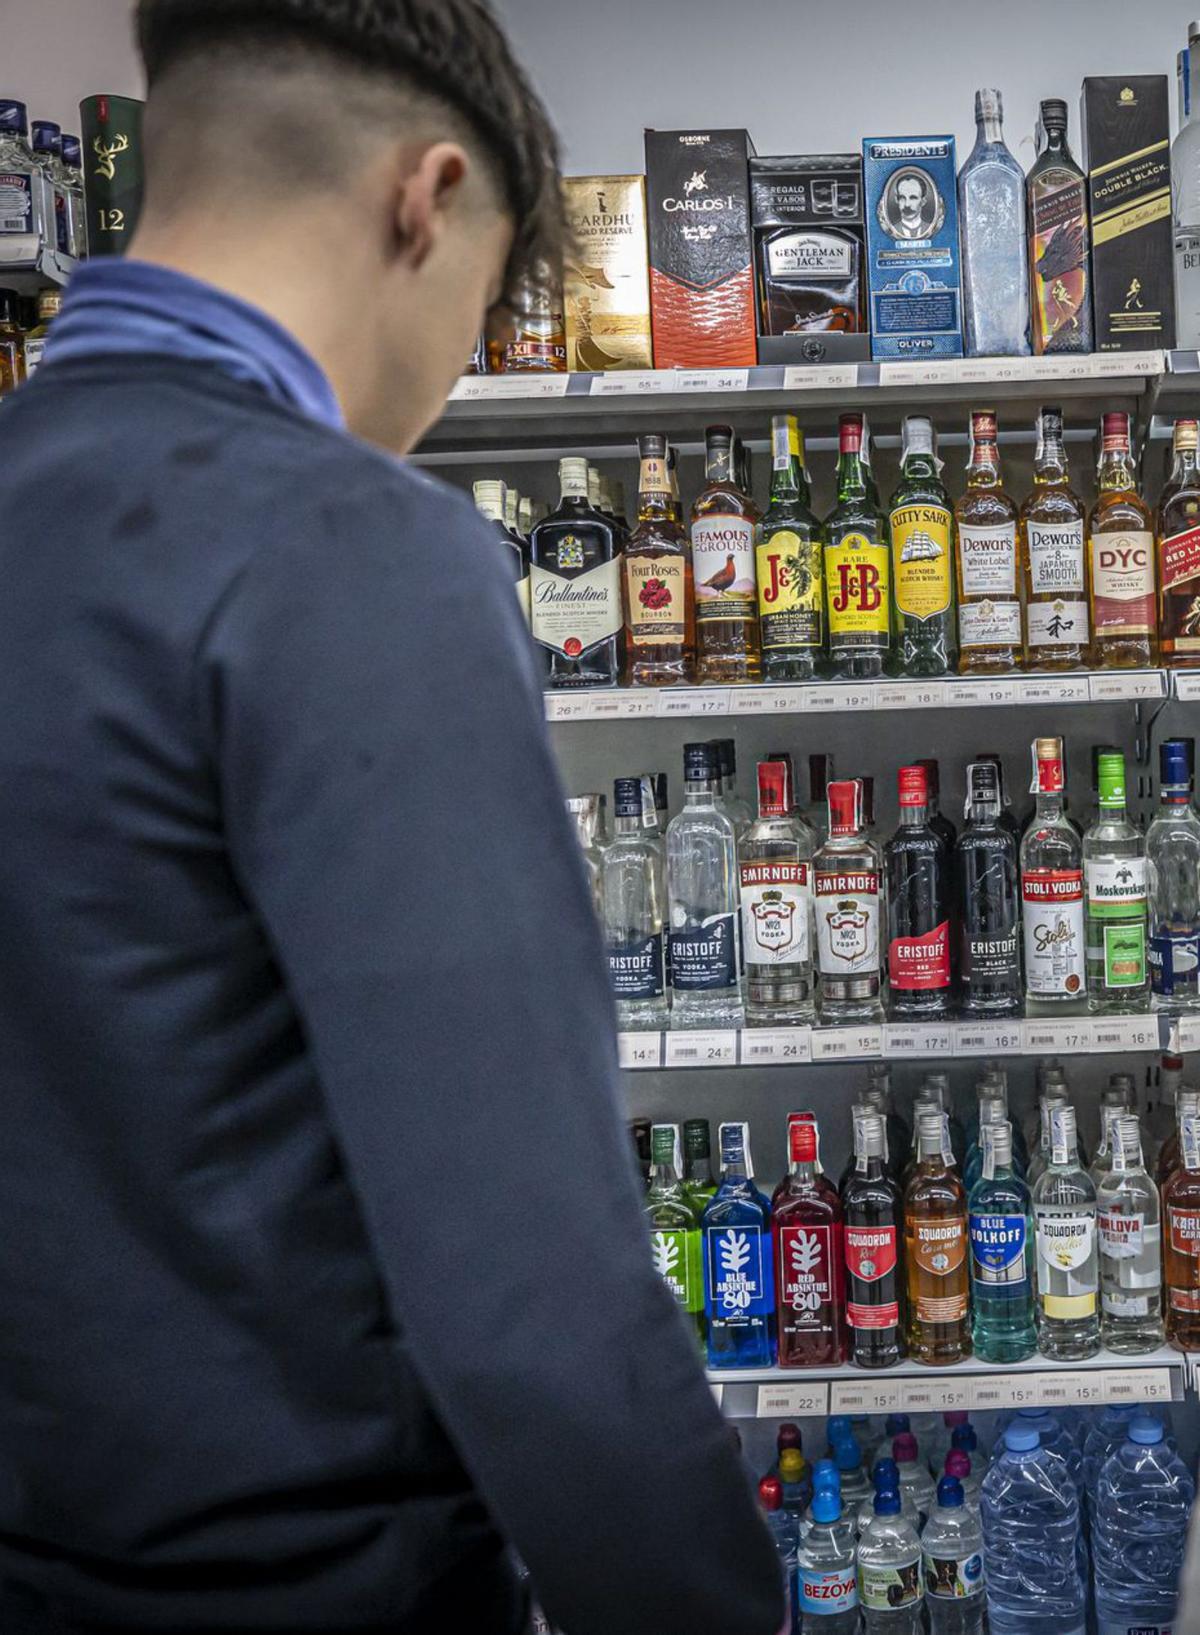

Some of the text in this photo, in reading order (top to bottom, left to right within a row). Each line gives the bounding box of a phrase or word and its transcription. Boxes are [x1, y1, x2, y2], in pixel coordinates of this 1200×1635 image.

[873, 144, 946, 158] PRESIDENTE
[1094, 178, 1133, 198] DOUBLE
[1135, 164, 1167, 182] BLACK
[770, 186, 805, 194] REGALO
[662, 198, 724, 213] CARLOS
[98, 209, 125, 231] 12
[775, 248, 844, 257] GENTLEMAN
[797, 257, 824, 267] JACK
[898, 339, 933, 349] OLIVER
[892, 510, 949, 528] CUTTY SARK
[700, 530, 749, 542] FAMOUS
[1031, 531, 1082, 547] Dewar's
[699, 541, 750, 553] GROUSE
[964, 537, 1013, 553] Dewar's
[1055, 550, 1062, 561] 8
[1100, 548, 1147, 569] DYC
[1166, 549, 1186, 564] RED
[631, 563, 680, 577] Four Roses
[1039, 560, 1078, 569] JAPANESE
[1039, 569, 1078, 580] SMOOTH
[535, 580, 609, 604] Ballantine's
[990, 692, 1003, 700] 19
[1060, 689, 1075, 698] 22
[1134, 686, 1147, 695] 17
[846, 697, 859, 705] 19
[918, 694, 930, 703] 18
[742, 866, 804, 883] SMIRNOFF
[817, 876, 877, 893] SMIRNOFF
[1024, 880, 1081, 895] STOLI VODKA
[672, 940, 722, 956] ERISTOFF
[897, 943, 945, 959] ERISTOFF
[970, 938, 1017, 954] ERISTOFF
[986, 959, 1007, 967] BLACK
[858, 1038, 870, 1047] 15
[925, 1038, 938, 1048] 17
[995, 1036, 1009, 1047] 16
[1065, 1035, 1078, 1046] 17
[1132, 1033, 1145, 1043] 16
[632, 1050, 646, 1060] 14
[707, 1048, 722, 1059] 24
[783, 1045, 798, 1056] 24
[980, 1218, 1006, 1229] BLUE
[918, 1224, 962, 1241] SQUADRON
[1043, 1223, 1087, 1237] SQUADRON
[848, 1232, 891, 1247] SQUADRON
[725, 1272, 747, 1283] BLUE
[797, 1273, 816, 1284] RED
[716, 1281, 757, 1292] ABSINTHE
[786, 1281, 828, 1293] ABSINTHE
[722, 1290, 751, 1309] 80
[791, 1292, 822, 1311] 80
[1010, 1390, 1024, 1401] 15
[1076, 1388, 1090, 1398] 15
[1143, 1385, 1157, 1395] 15
[799, 1398, 814, 1409] 22
[873, 1395, 887, 1406] 15
[940, 1393, 955, 1404] 15
[803, 1577, 857, 1600] BEZOYA
